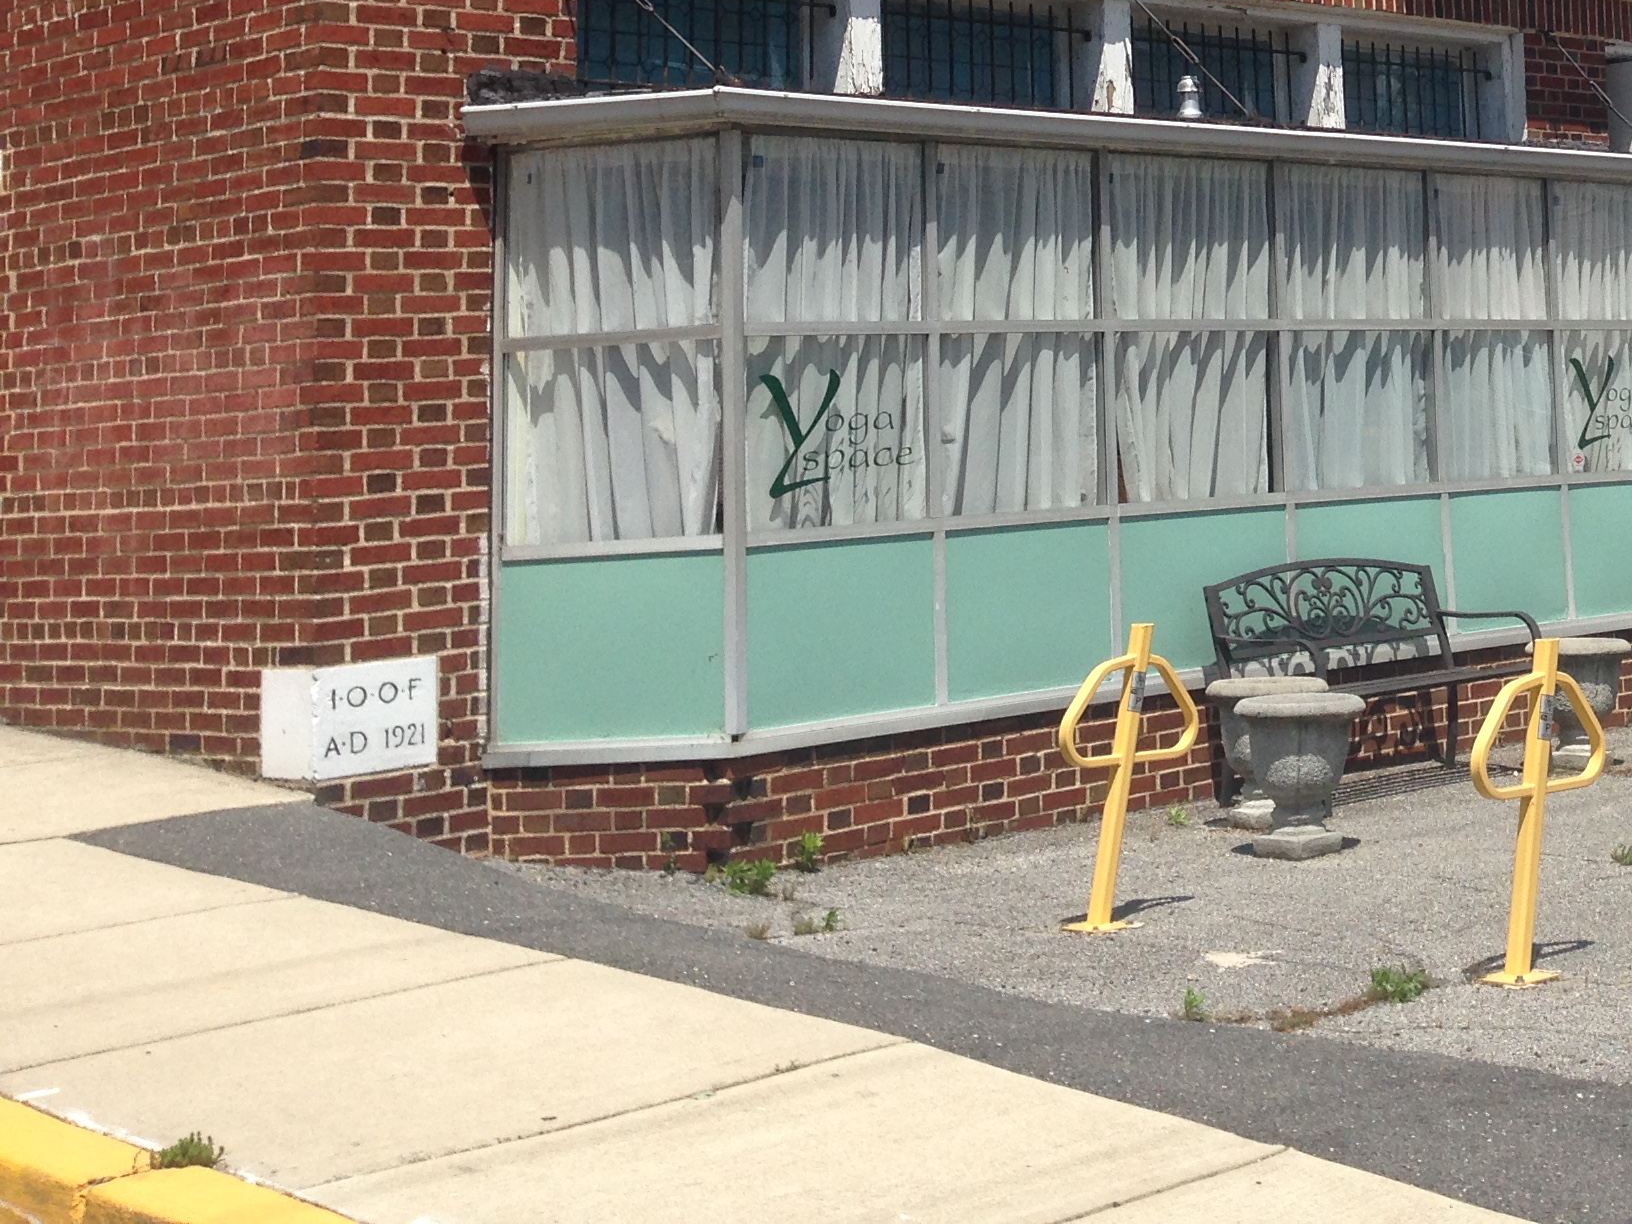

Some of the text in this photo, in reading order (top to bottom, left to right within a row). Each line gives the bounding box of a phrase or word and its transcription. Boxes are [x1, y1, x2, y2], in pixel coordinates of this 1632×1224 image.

[759, 368, 894, 498] Yoga
[803, 446, 915, 478] space
[384, 723, 425, 749] 1921
